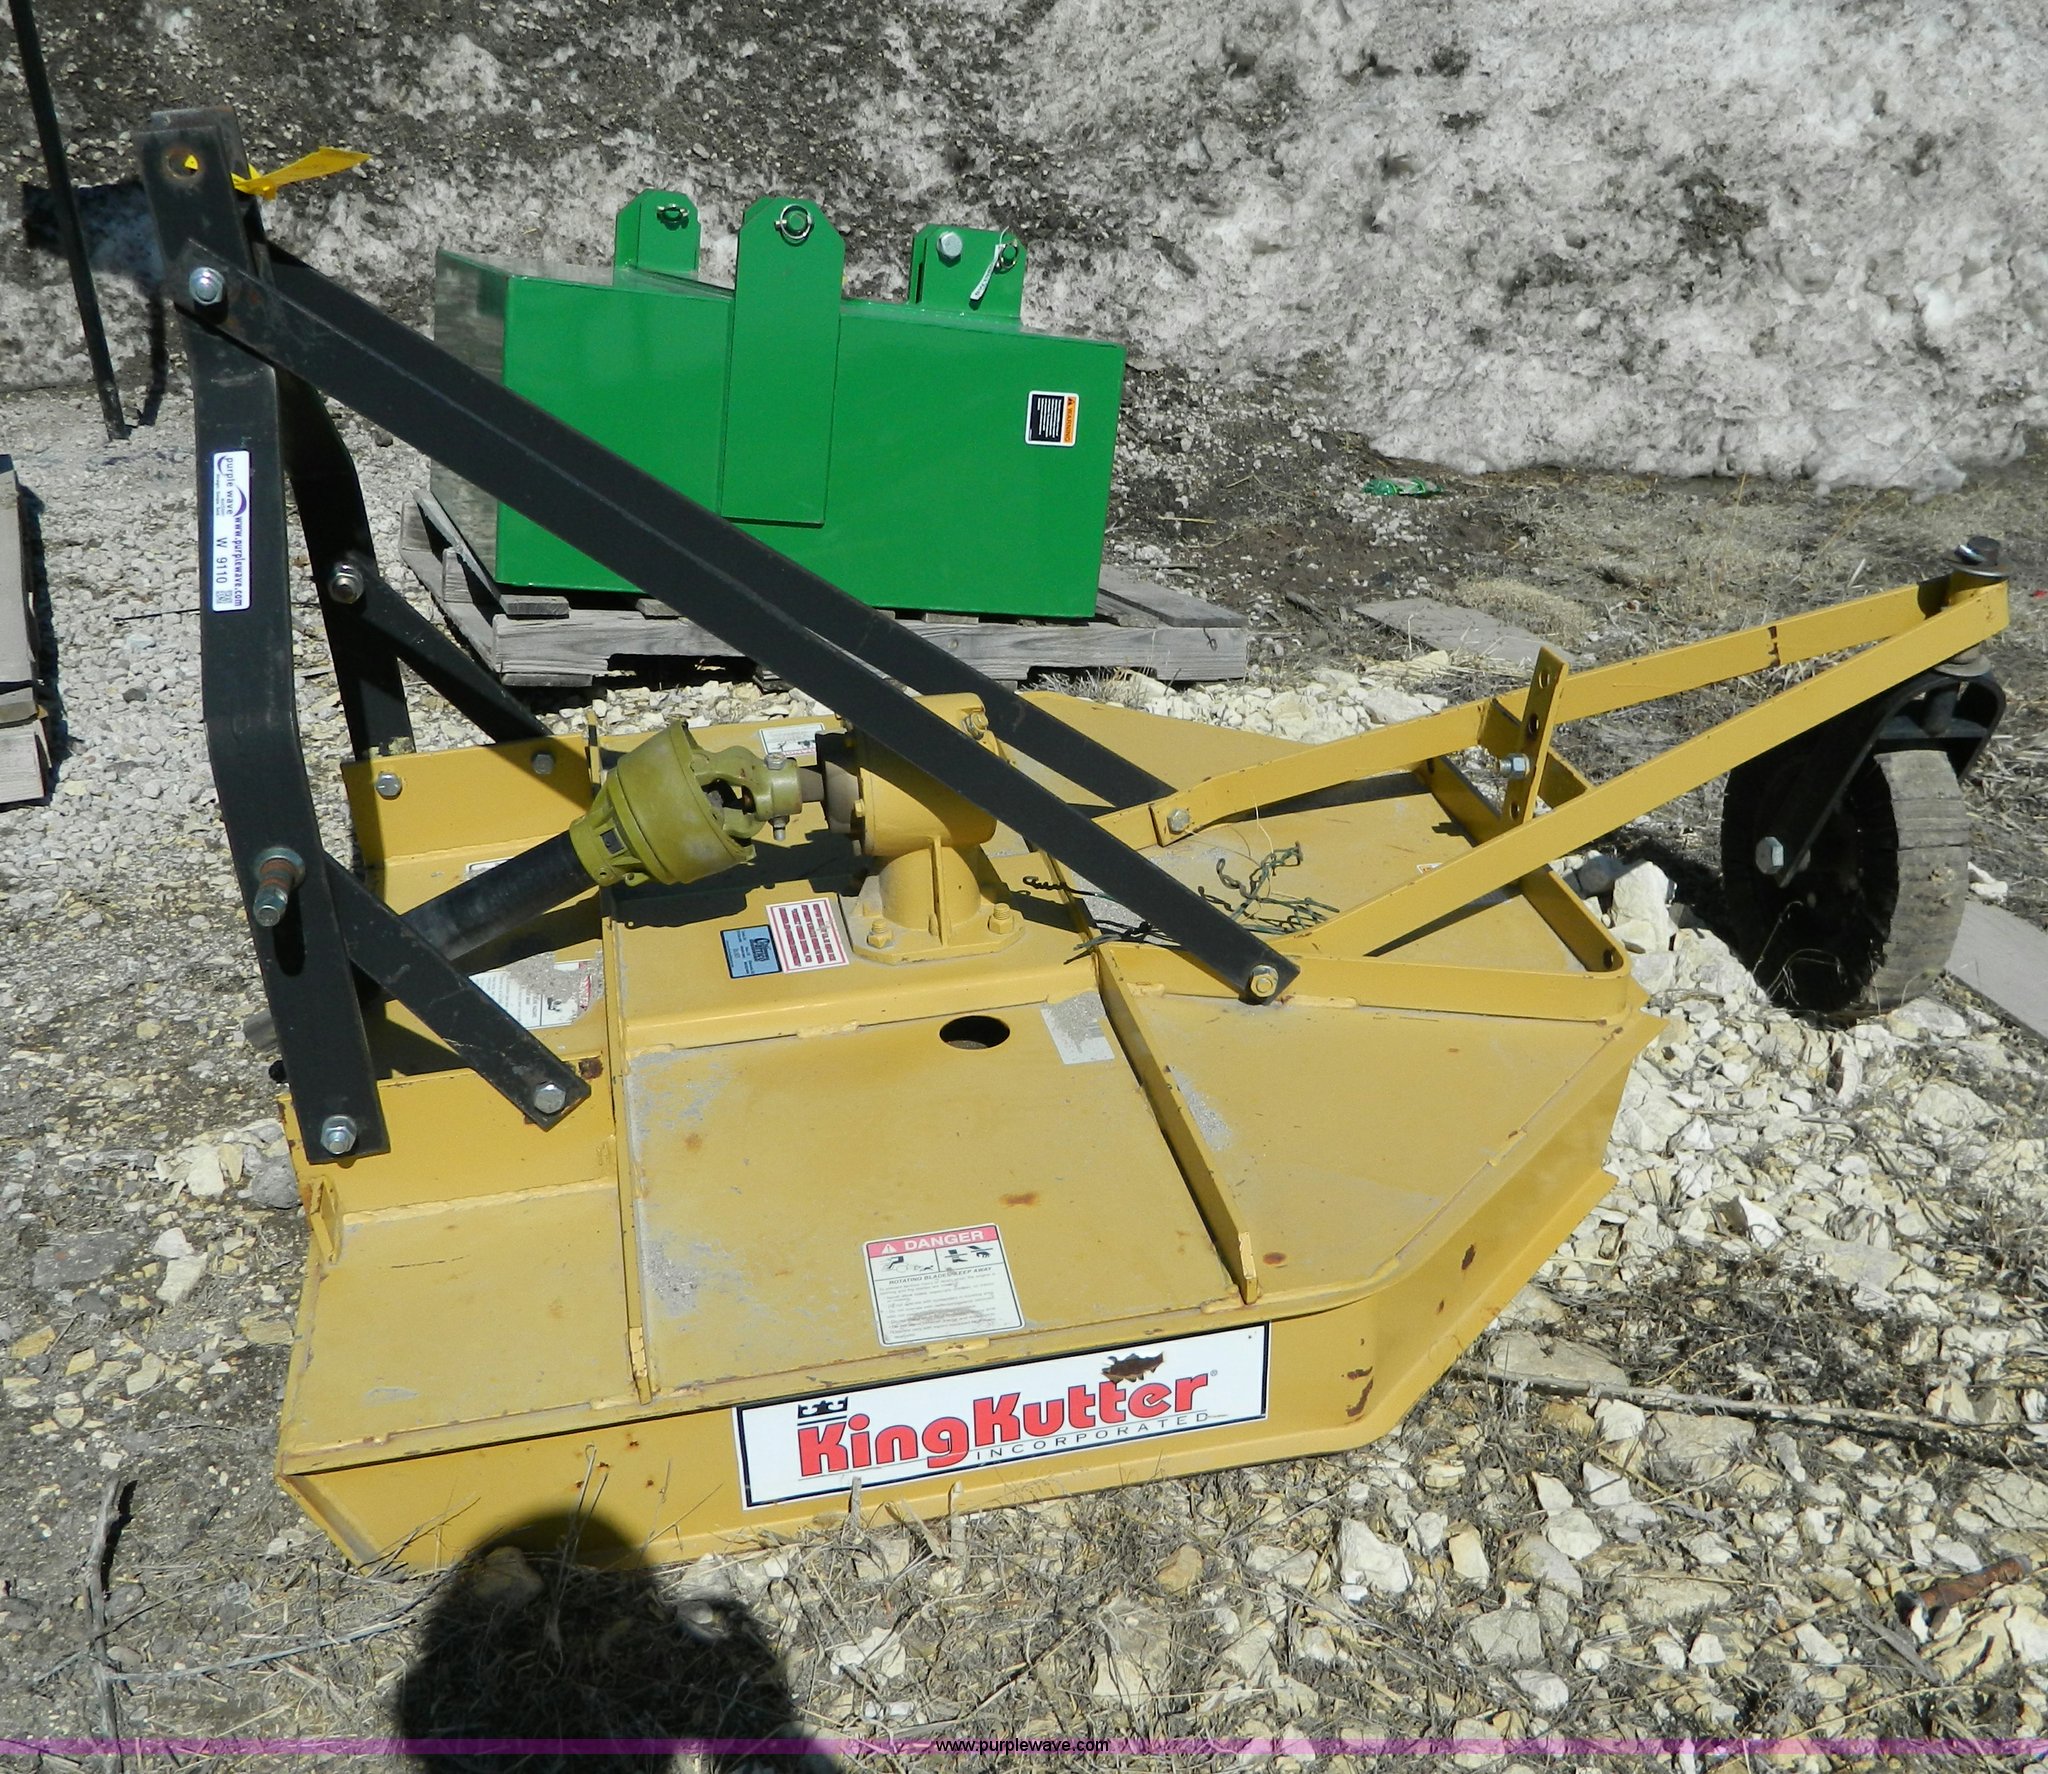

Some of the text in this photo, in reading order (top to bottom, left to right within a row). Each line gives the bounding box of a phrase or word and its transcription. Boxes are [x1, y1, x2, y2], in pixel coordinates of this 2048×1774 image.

[226, 457, 235, 487] purple
[216, 537, 228, 584] W 9110
[232, 516, 245, 607] www.purplewave.com
[904, 1230, 984, 1251] DANGER
[889, 1275, 922, 1285] ROTATING
[973, 1266, 992, 1274] AWAY
[977, 1411, 1210, 1461] INCORPORATED
